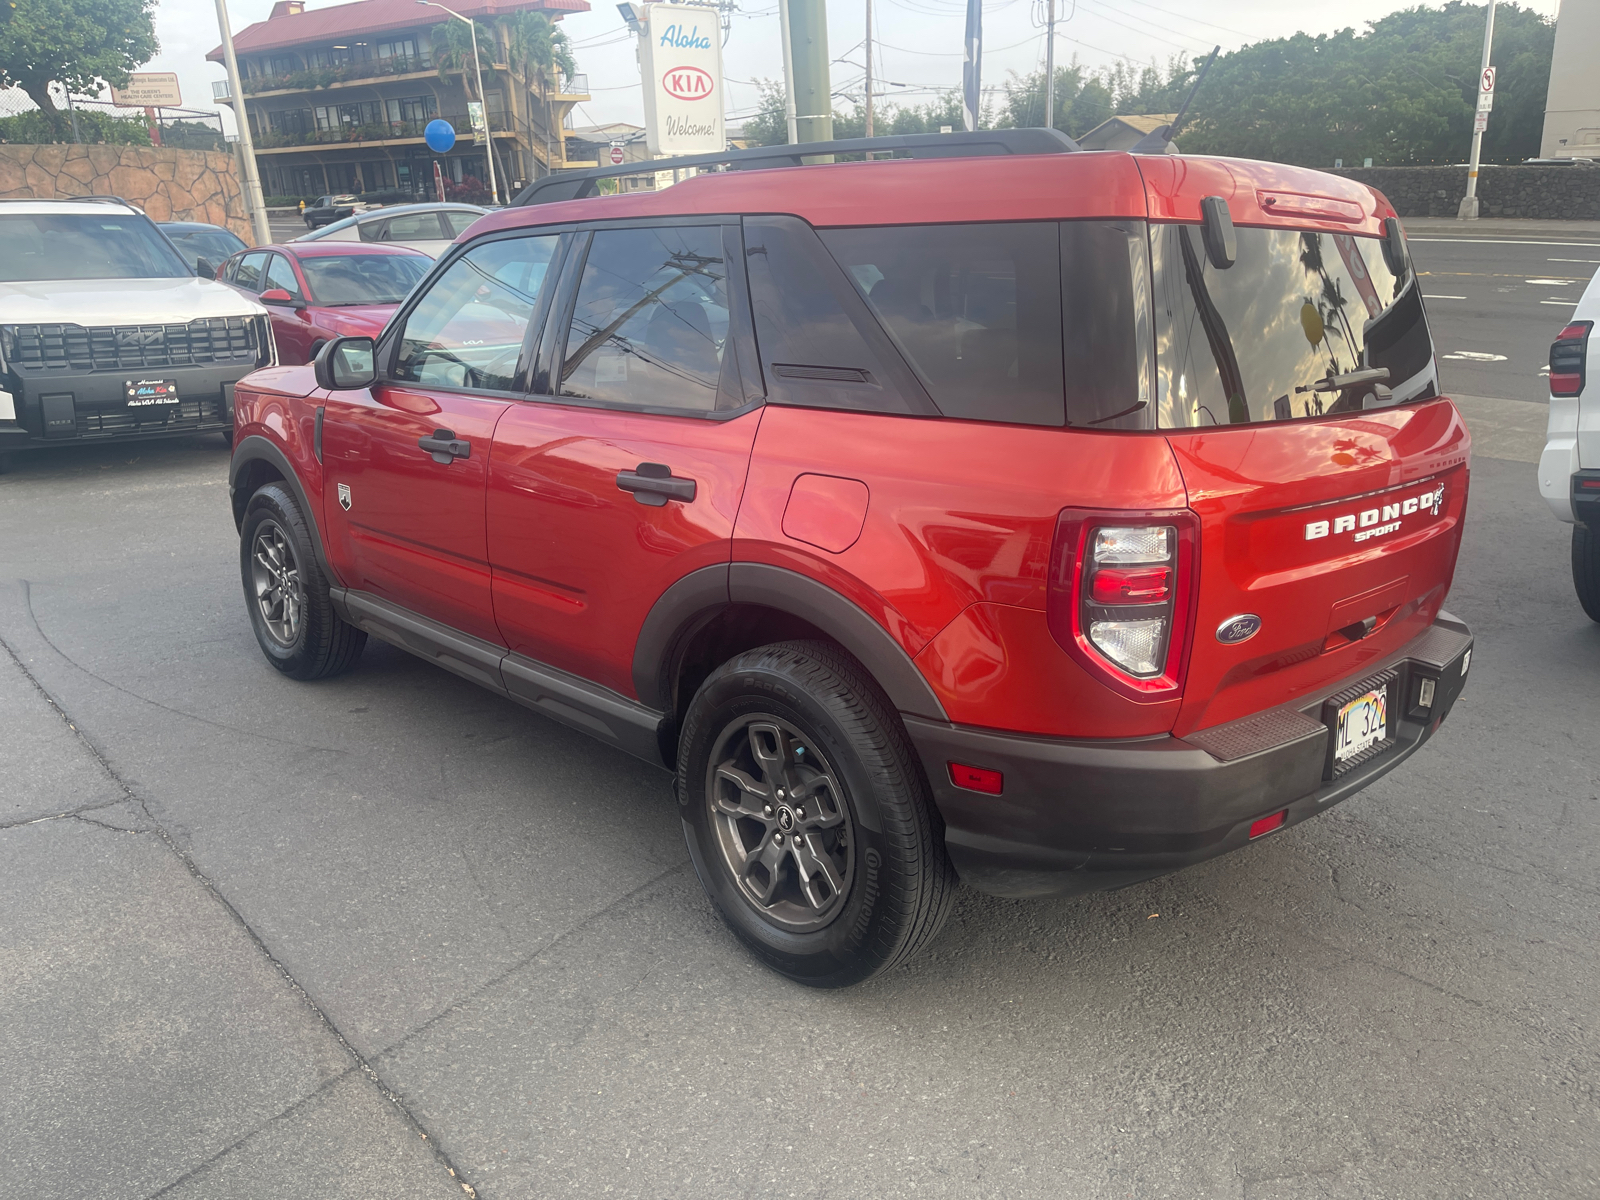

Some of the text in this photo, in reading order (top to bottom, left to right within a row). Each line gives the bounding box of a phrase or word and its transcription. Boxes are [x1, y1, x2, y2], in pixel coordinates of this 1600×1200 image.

[660, 24, 711, 50] Aloha
[671, 74, 707, 93] KIA
[666, 115, 717, 137] Welcome!
[137, 386, 155, 394] Aloha
[1304, 492, 1434, 541] BRONCO
[1353, 521, 1402, 543] SPORT
[1228, 621, 1254, 639] Ford
[1361, 693, 1386, 737] 322
[1340, 738, 1372, 760] ALOHA STATE
